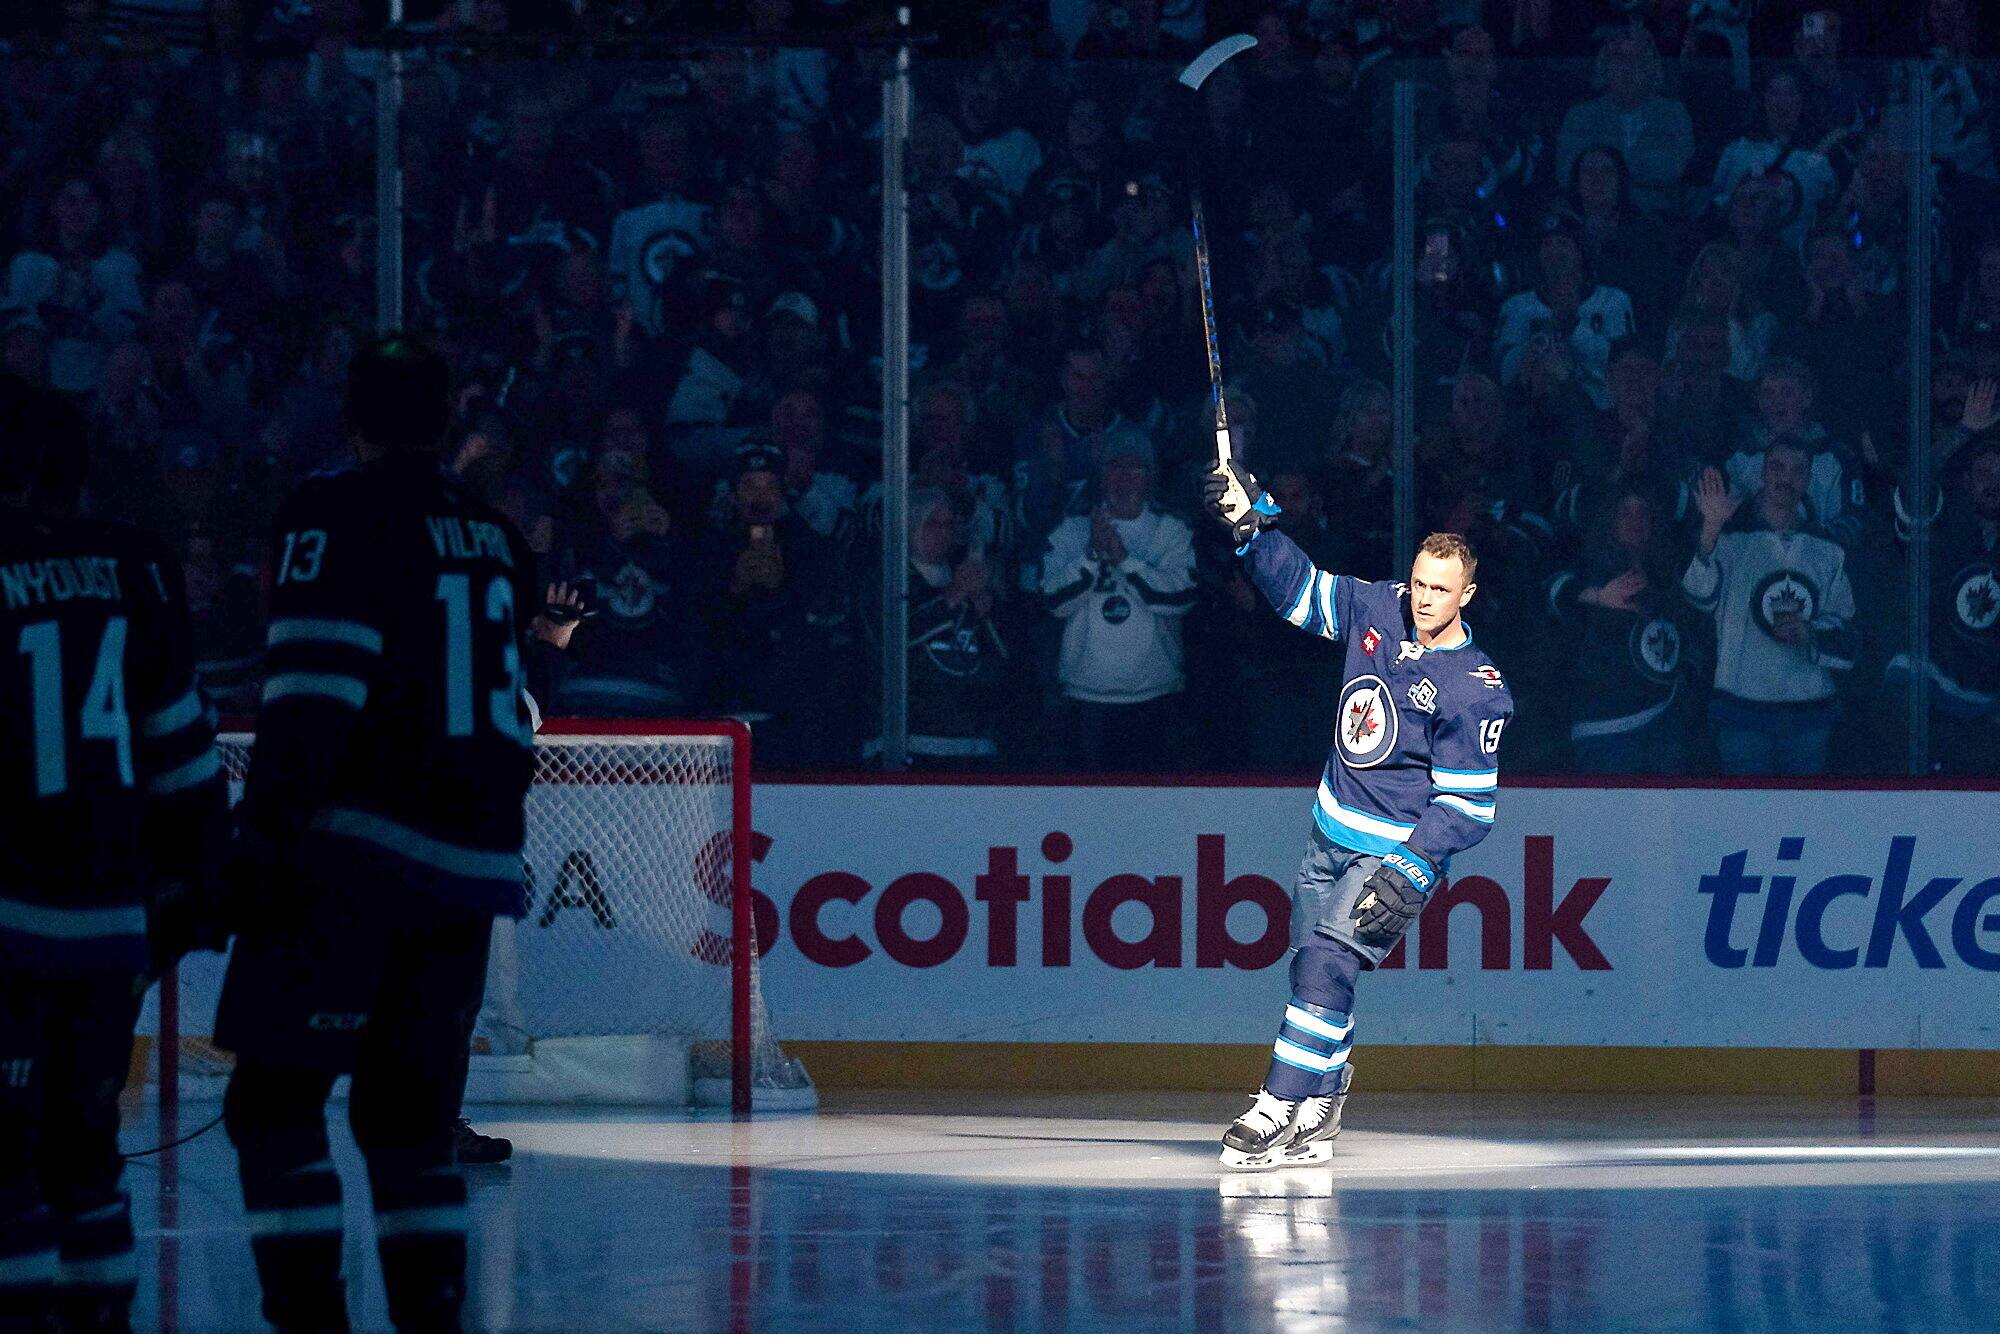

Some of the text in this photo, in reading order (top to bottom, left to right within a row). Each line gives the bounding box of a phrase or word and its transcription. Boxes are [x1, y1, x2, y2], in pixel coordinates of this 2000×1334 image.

[277, 529, 328, 586] 13
[17, 615, 136, 798] 14
[1479, 719, 1505, 754] 19
[691, 830, 1613, 971] Scotiabnk
